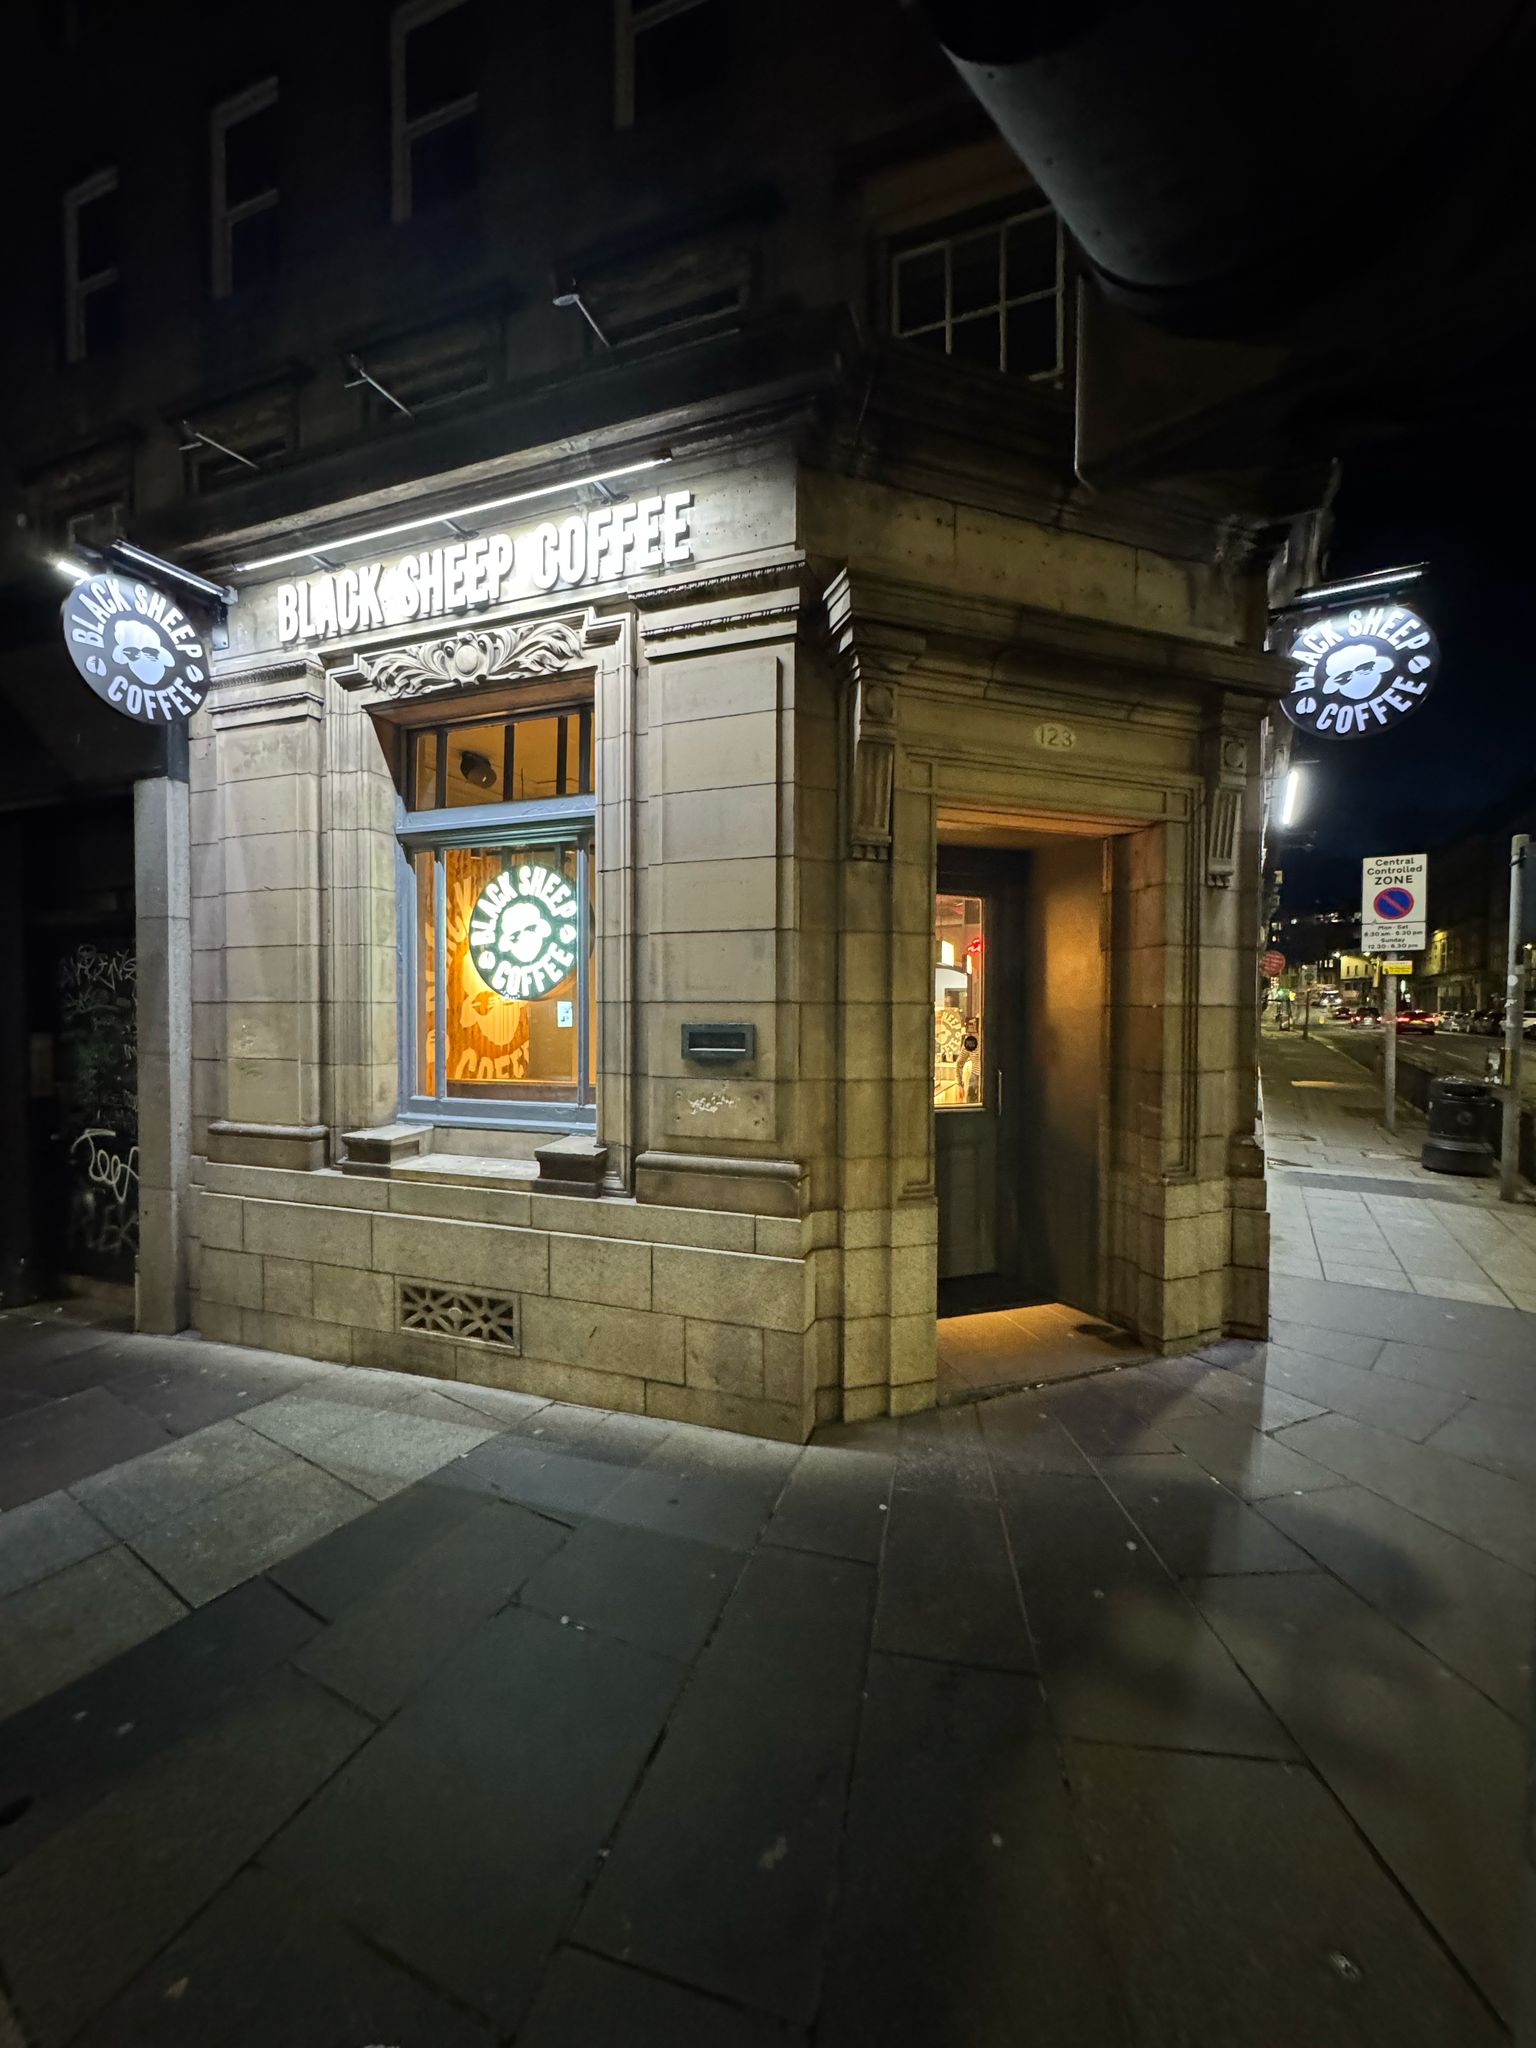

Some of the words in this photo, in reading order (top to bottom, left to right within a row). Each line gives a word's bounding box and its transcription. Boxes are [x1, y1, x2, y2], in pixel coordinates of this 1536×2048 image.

[277, 562, 384, 643] BLACK
[400, 533, 514, 618] SHEEP
[531, 490, 692, 590] COFFEE
[71, 578, 132, 649] BLACK
[134, 583, 203, 658] SHEEP
[1348, 607, 1430, 651] SHEEP
[108, 675, 202, 721] COFFEE
[1316, 675, 1428, 734] COFFEE
[1040, 726, 1073, 748] 123
[1367, 865, 1423, 876] Controlled
[1374, 875, 1414, 886] ZONE
[1375, 857, 1415, 867] Central
[470, 871, 518, 946] BLACK
[518, 865, 577, 918] SHEEP
[491, 942, 575, 997] COFFEE
